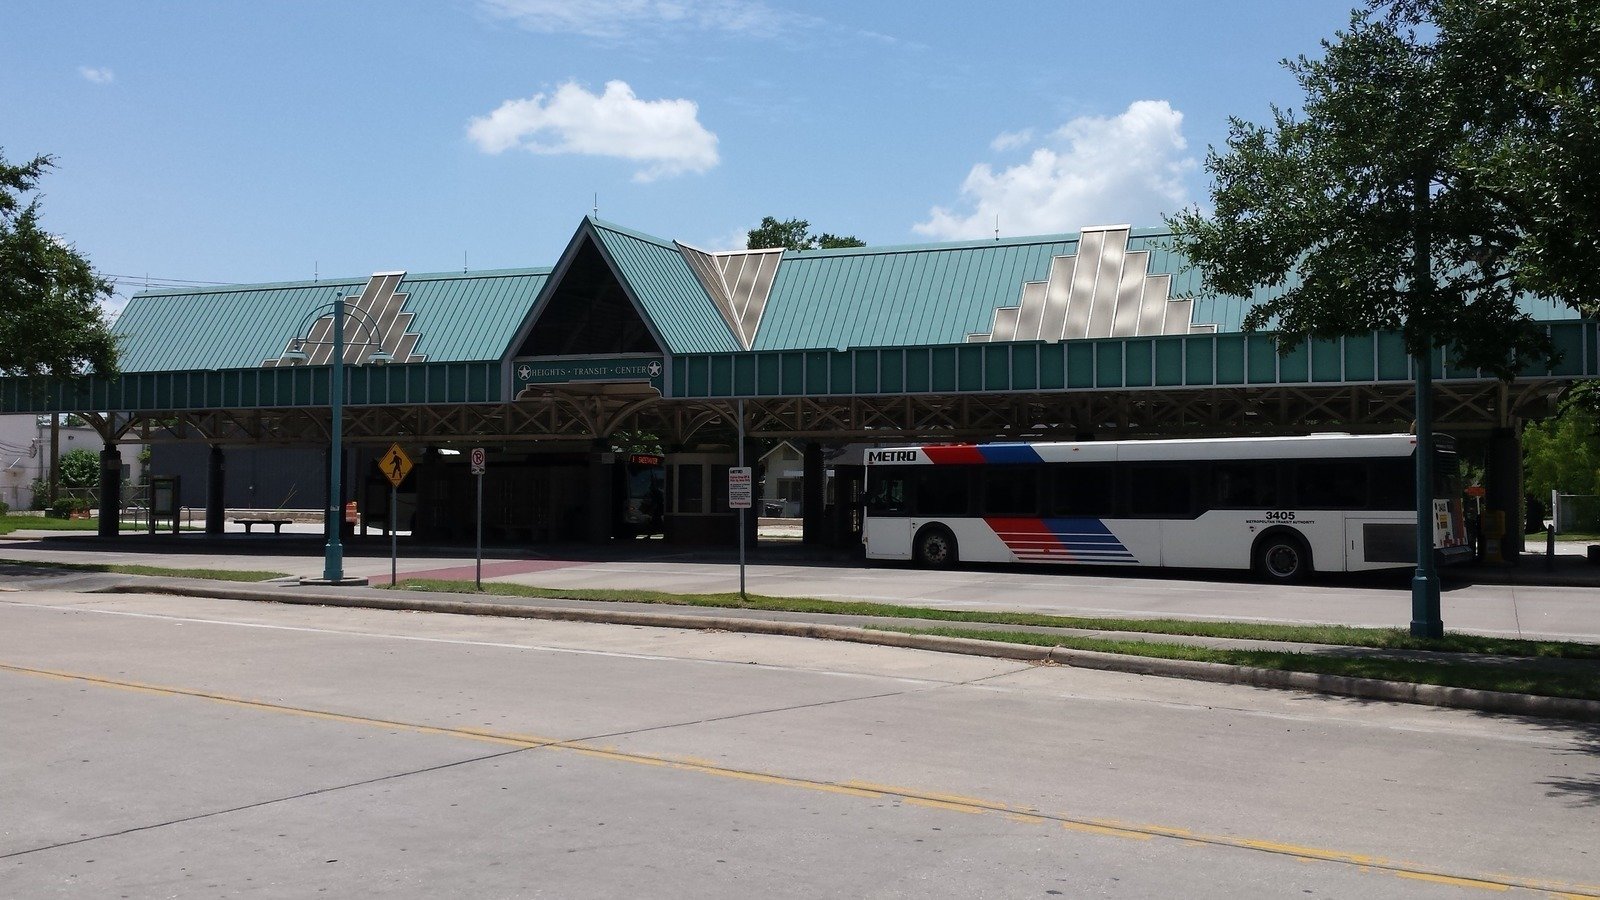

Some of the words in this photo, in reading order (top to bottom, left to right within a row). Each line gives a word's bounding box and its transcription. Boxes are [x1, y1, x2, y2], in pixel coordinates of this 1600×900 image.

[531, 368, 566, 377] HEIGHTS
[574, 367, 607, 376] TRANSIT
[615, 365, 648, 374] CENTER
[868, 451, 917, 462] METRO
[1265, 511, 1295, 520] 3405
